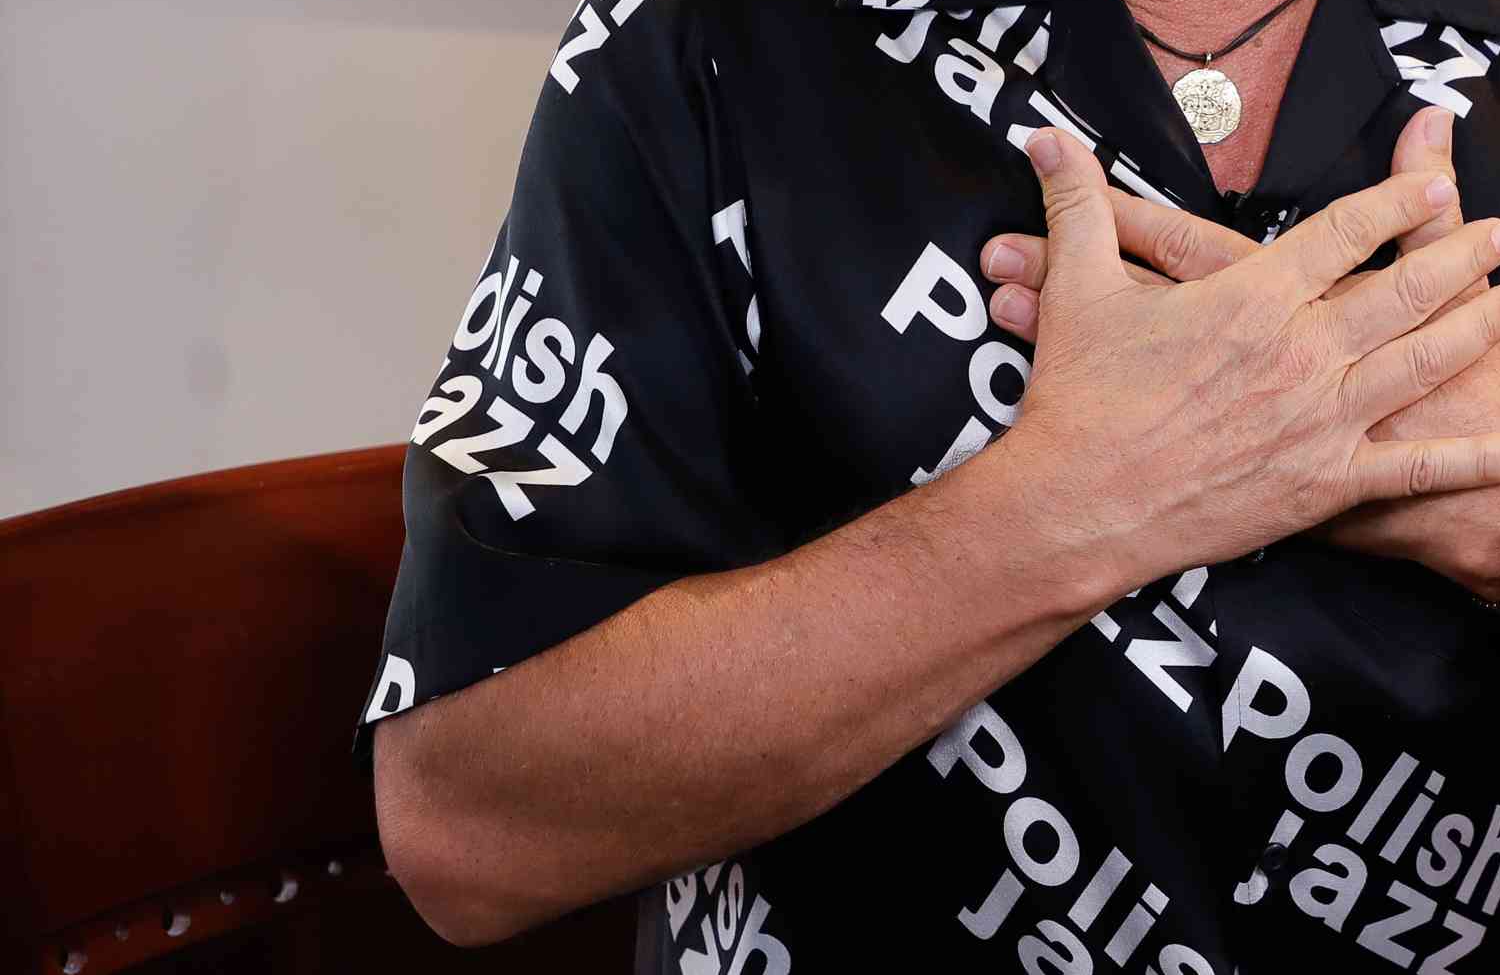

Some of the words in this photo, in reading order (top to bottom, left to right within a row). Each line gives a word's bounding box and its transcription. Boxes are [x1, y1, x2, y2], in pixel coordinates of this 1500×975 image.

[411, 358, 594, 522] azz
[453, 254, 628, 466] olish
[1233, 809, 1487, 975] jazz
